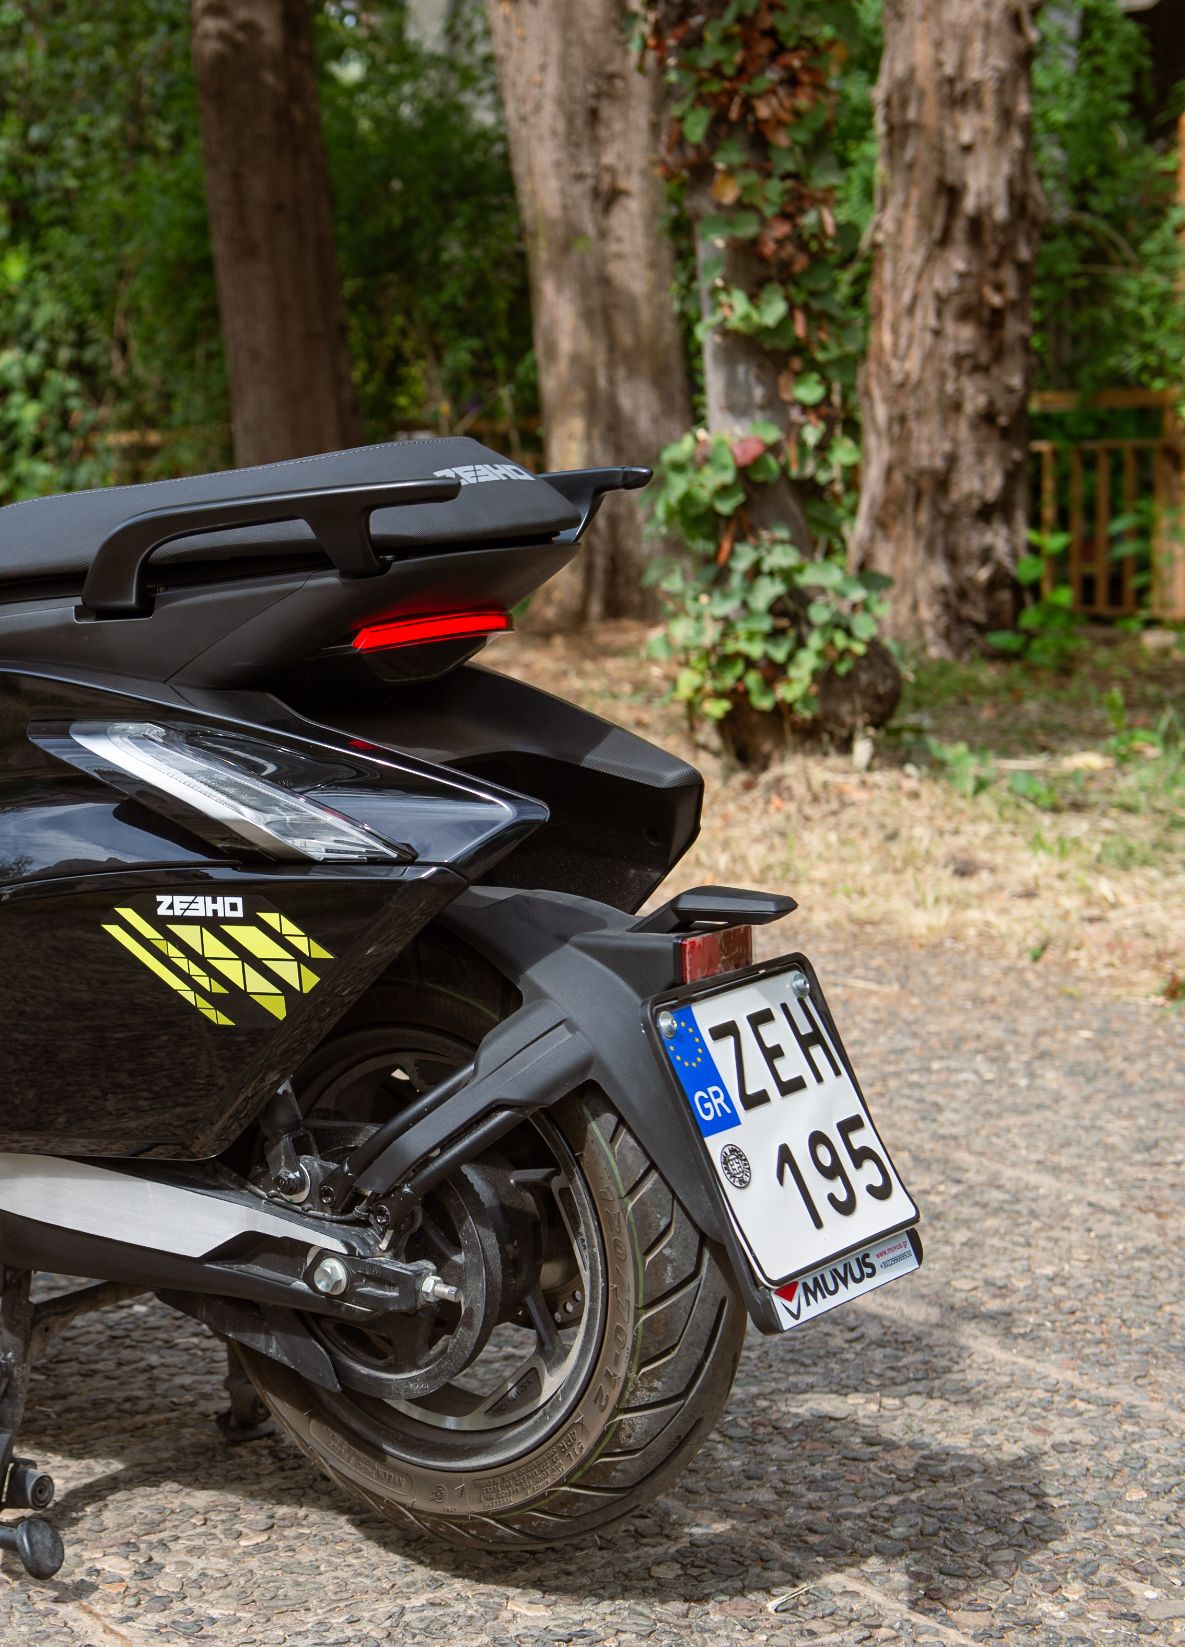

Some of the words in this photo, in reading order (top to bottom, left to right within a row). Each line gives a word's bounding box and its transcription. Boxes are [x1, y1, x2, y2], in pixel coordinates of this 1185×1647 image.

[155, 895, 244, 918] ZEEHO
[708, 997, 843, 1112] ZEH
[694, 1084, 734, 1122] GR
[775, 1113, 894, 1231] 195
[801, 1252, 877, 1307] MUVUS
